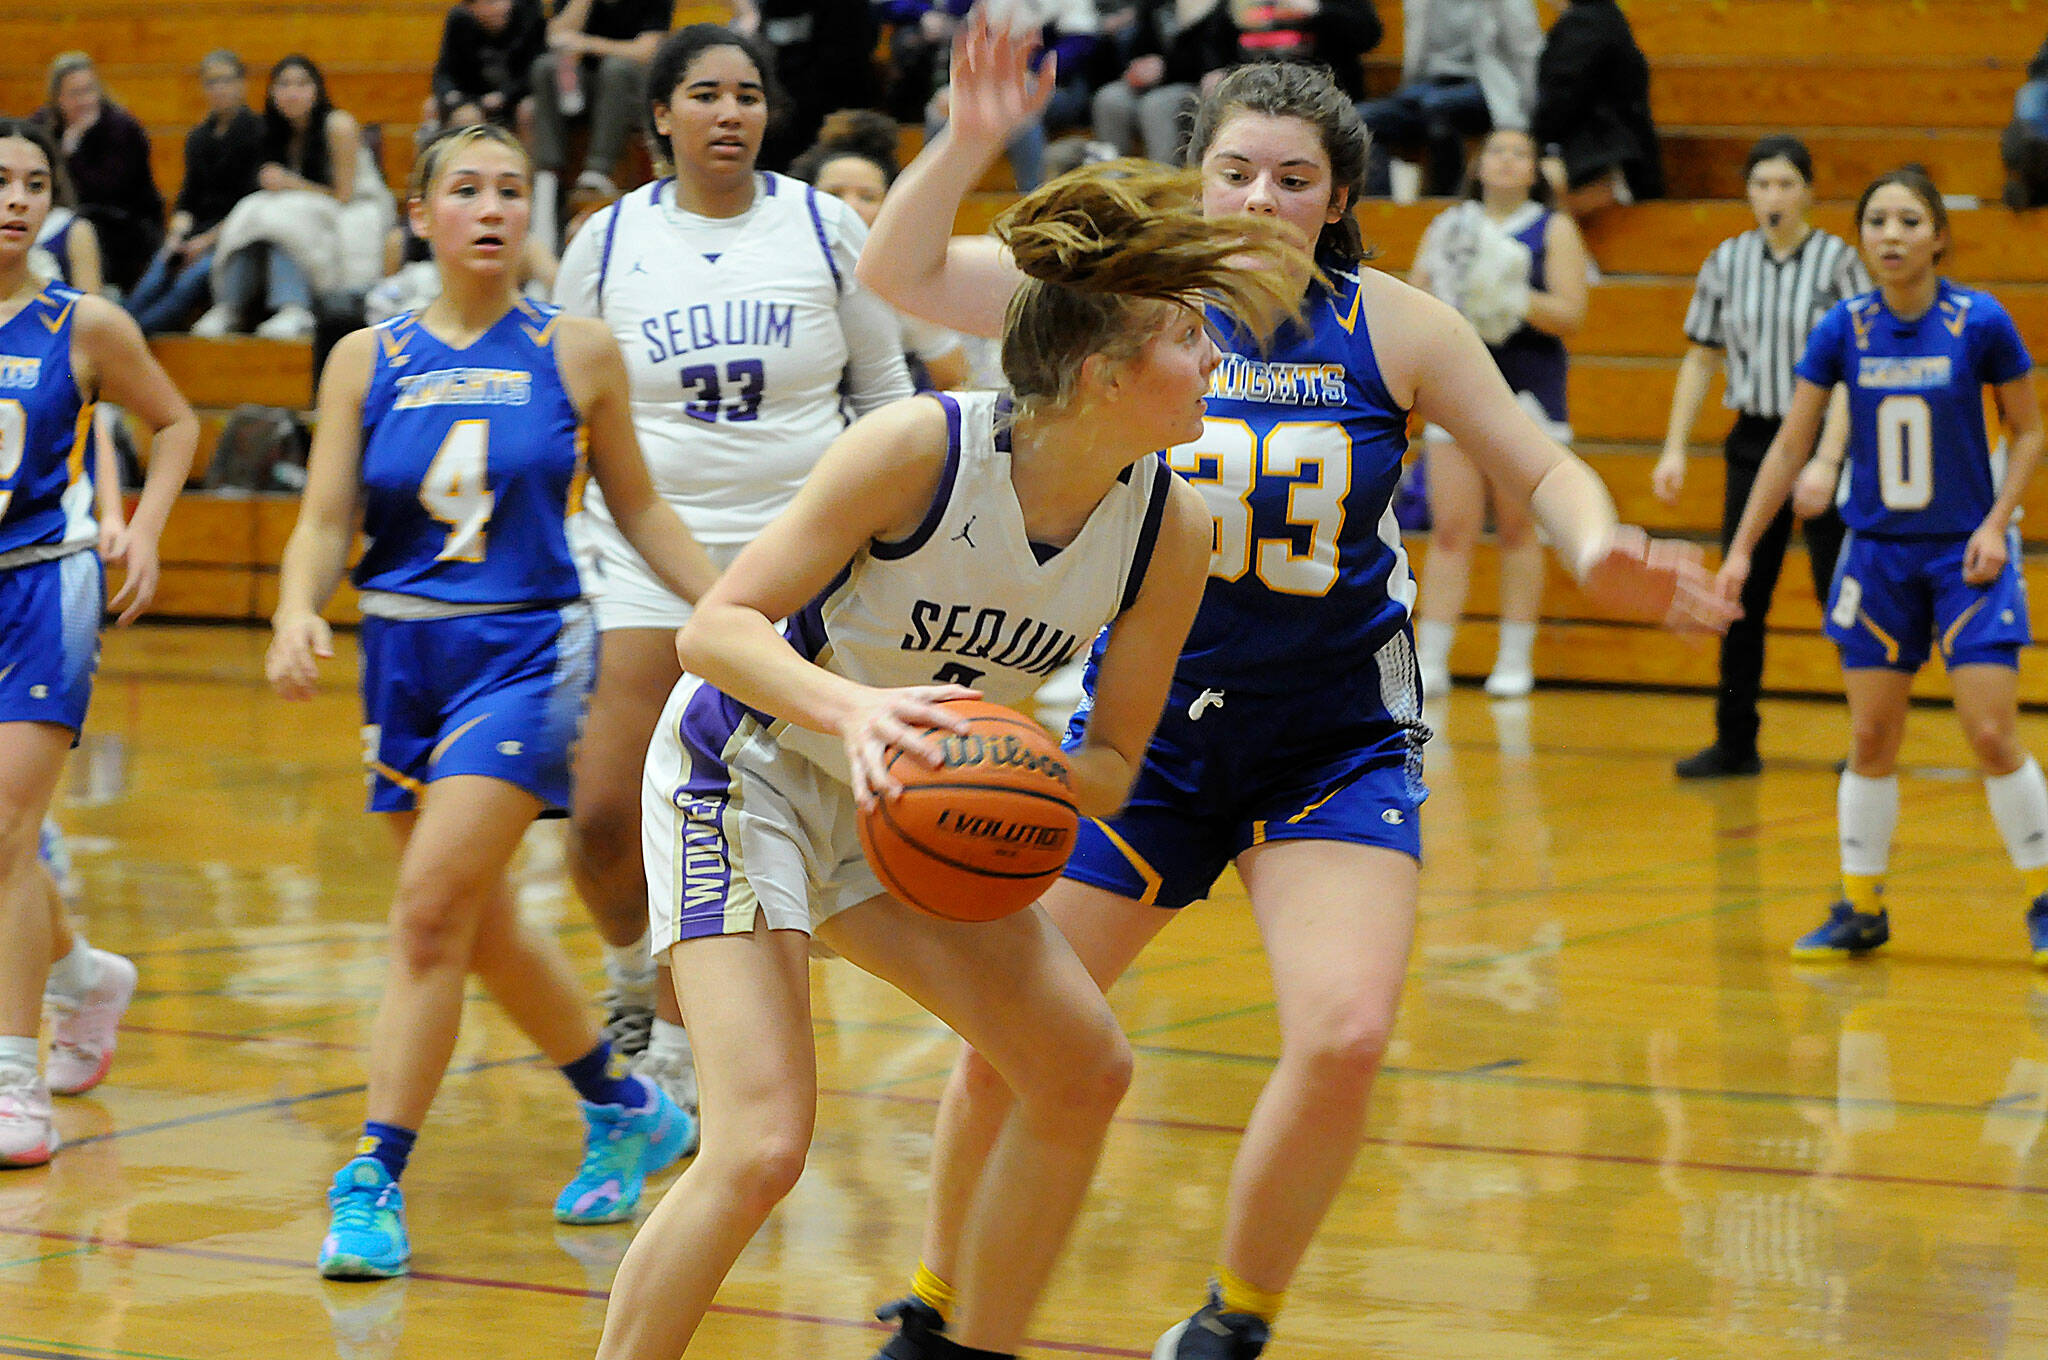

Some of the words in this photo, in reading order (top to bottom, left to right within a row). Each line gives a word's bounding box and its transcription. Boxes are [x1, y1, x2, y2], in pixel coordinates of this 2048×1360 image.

[641, 299, 795, 364] SEQUIM
[1202, 352, 1348, 407] NIGHTS
[680, 358, 765, 423] 33
[417, 418, 495, 563] 4
[1166, 415, 1352, 597] 33
[1876, 395, 1932, 510] 0
[676, 791, 723, 910] WOLVES
